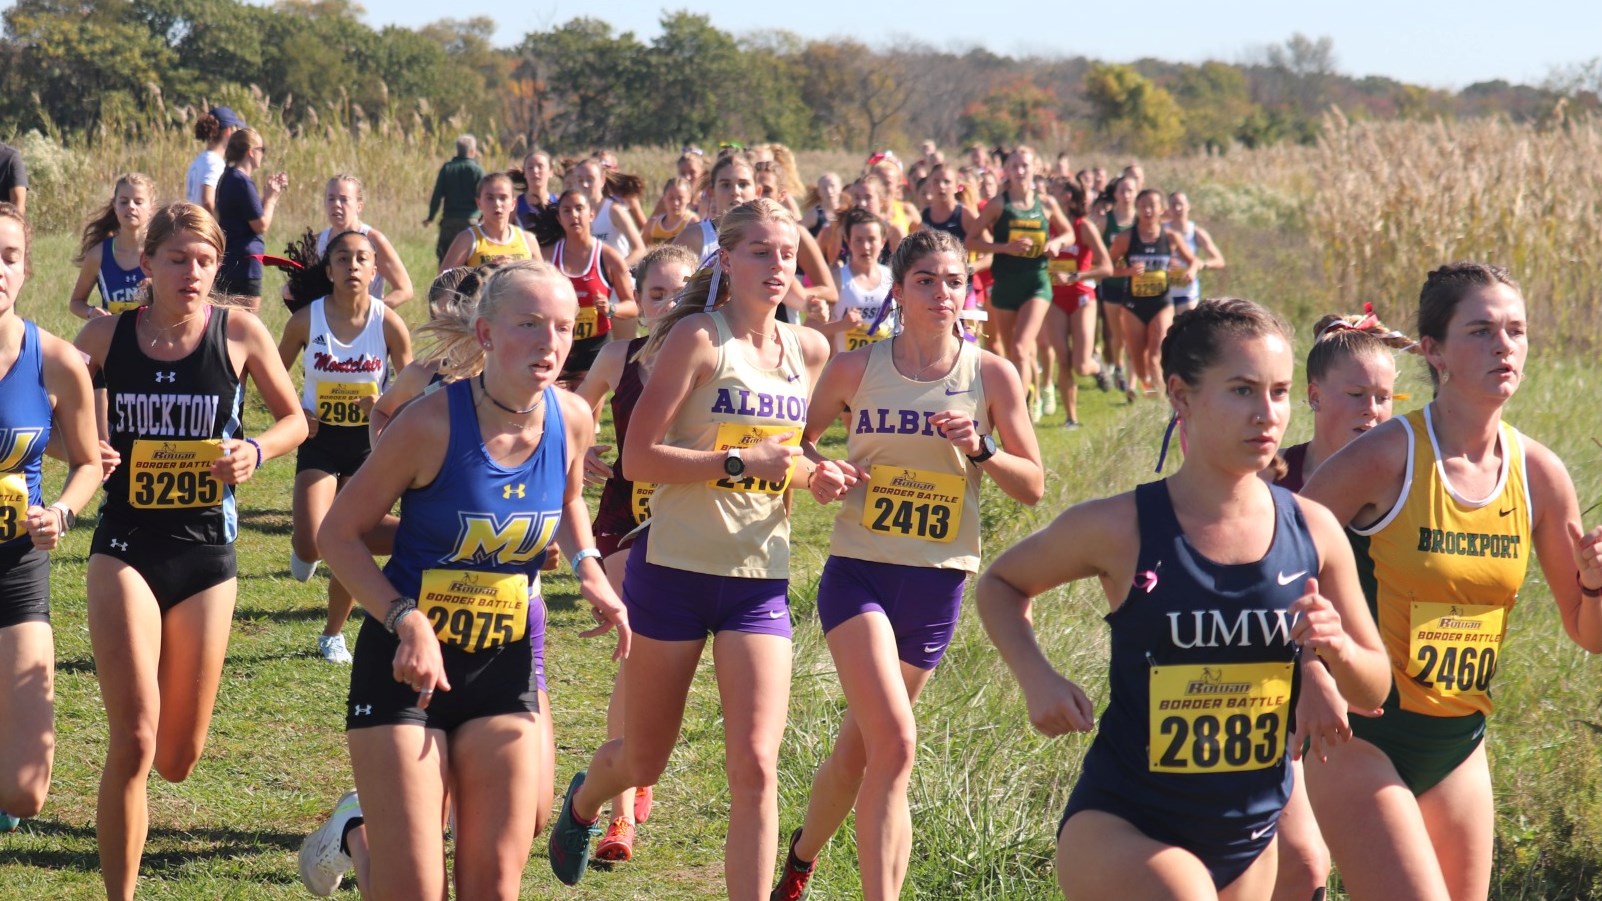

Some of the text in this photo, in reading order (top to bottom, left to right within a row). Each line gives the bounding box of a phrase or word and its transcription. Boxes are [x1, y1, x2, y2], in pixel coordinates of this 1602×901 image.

[314, 352, 382, 373] Montclair
[115, 393, 219, 437] STOCKTON
[152, 450, 196, 460] Rowan
[135, 460, 216, 469] BORDER BATTL
[135, 471, 218, 506] 3295
[891, 478, 935, 491] Rowan
[872, 486, 959, 504] BORDER BATTLE
[872, 497, 951, 539] 2413
[1418, 527, 1521, 559] BROCKPORT
[449, 582, 498, 596] Rowan
[426, 592, 523, 610] BORDER BATTLE
[426, 606, 514, 652] 2975
[1166, 609, 1300, 648] UMW
[1439, 618, 1482, 629] Rowan
[1417, 631, 1502, 643] BORDER BATTLE
[1411, 645, 1496, 692] 2460
[1187, 682, 1251, 695] Rowan
[1159, 696, 1284, 711] BORDER BATTLE
[1159, 713, 1280, 769] 2883
